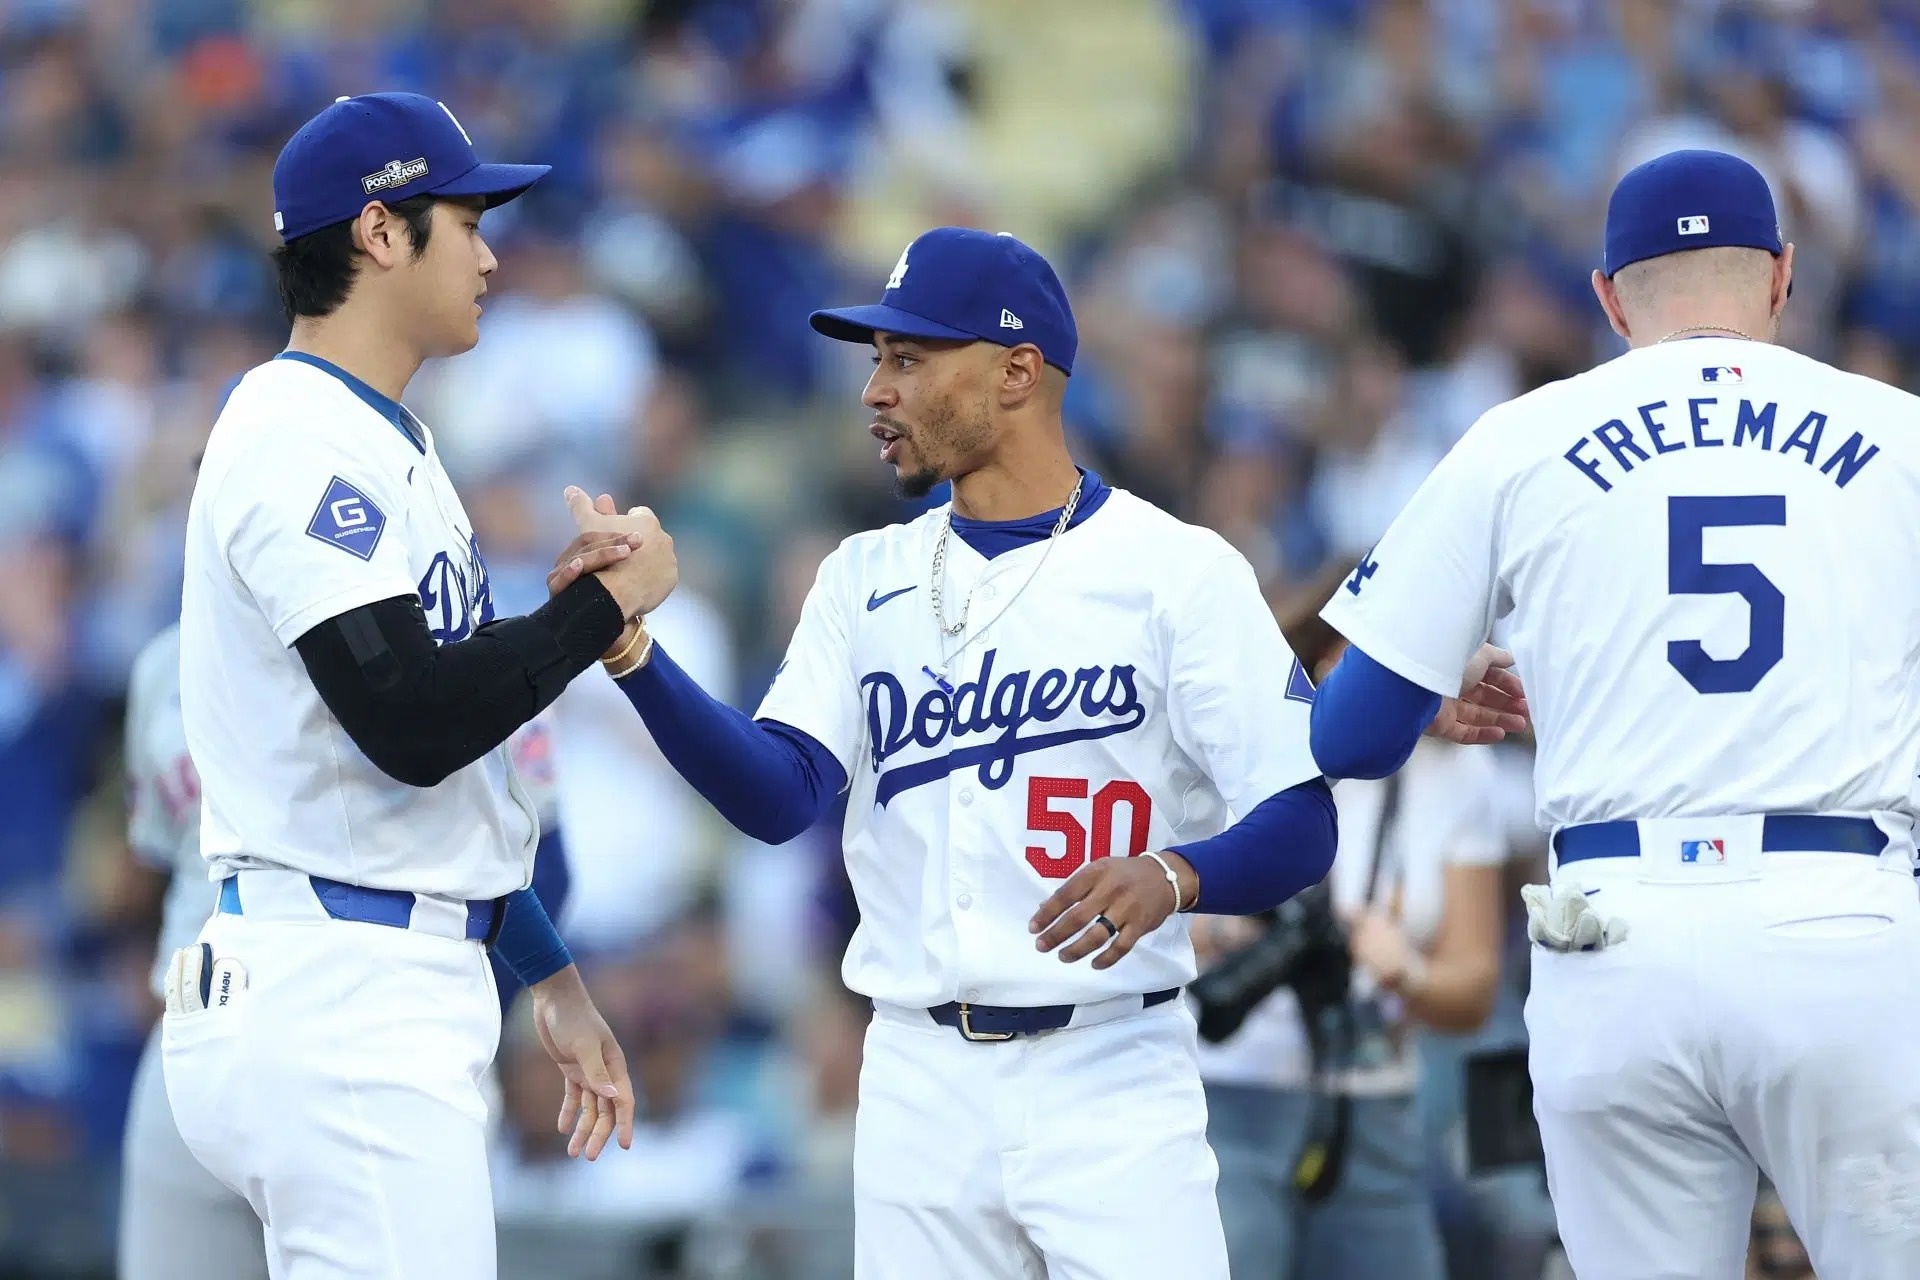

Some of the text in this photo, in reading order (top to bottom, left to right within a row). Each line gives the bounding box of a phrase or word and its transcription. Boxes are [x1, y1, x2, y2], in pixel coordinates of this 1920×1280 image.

[365, 162, 426, 189] POSTSEASON
[1563, 398, 1880, 492] FREEMAN
[331, 497, 367, 528] G
[1667, 495, 1786, 694] 5
[861, 648, 1146, 790] Dodgers
[1025, 776, 1151, 878] 50
[222, 971, 231, 994] new
